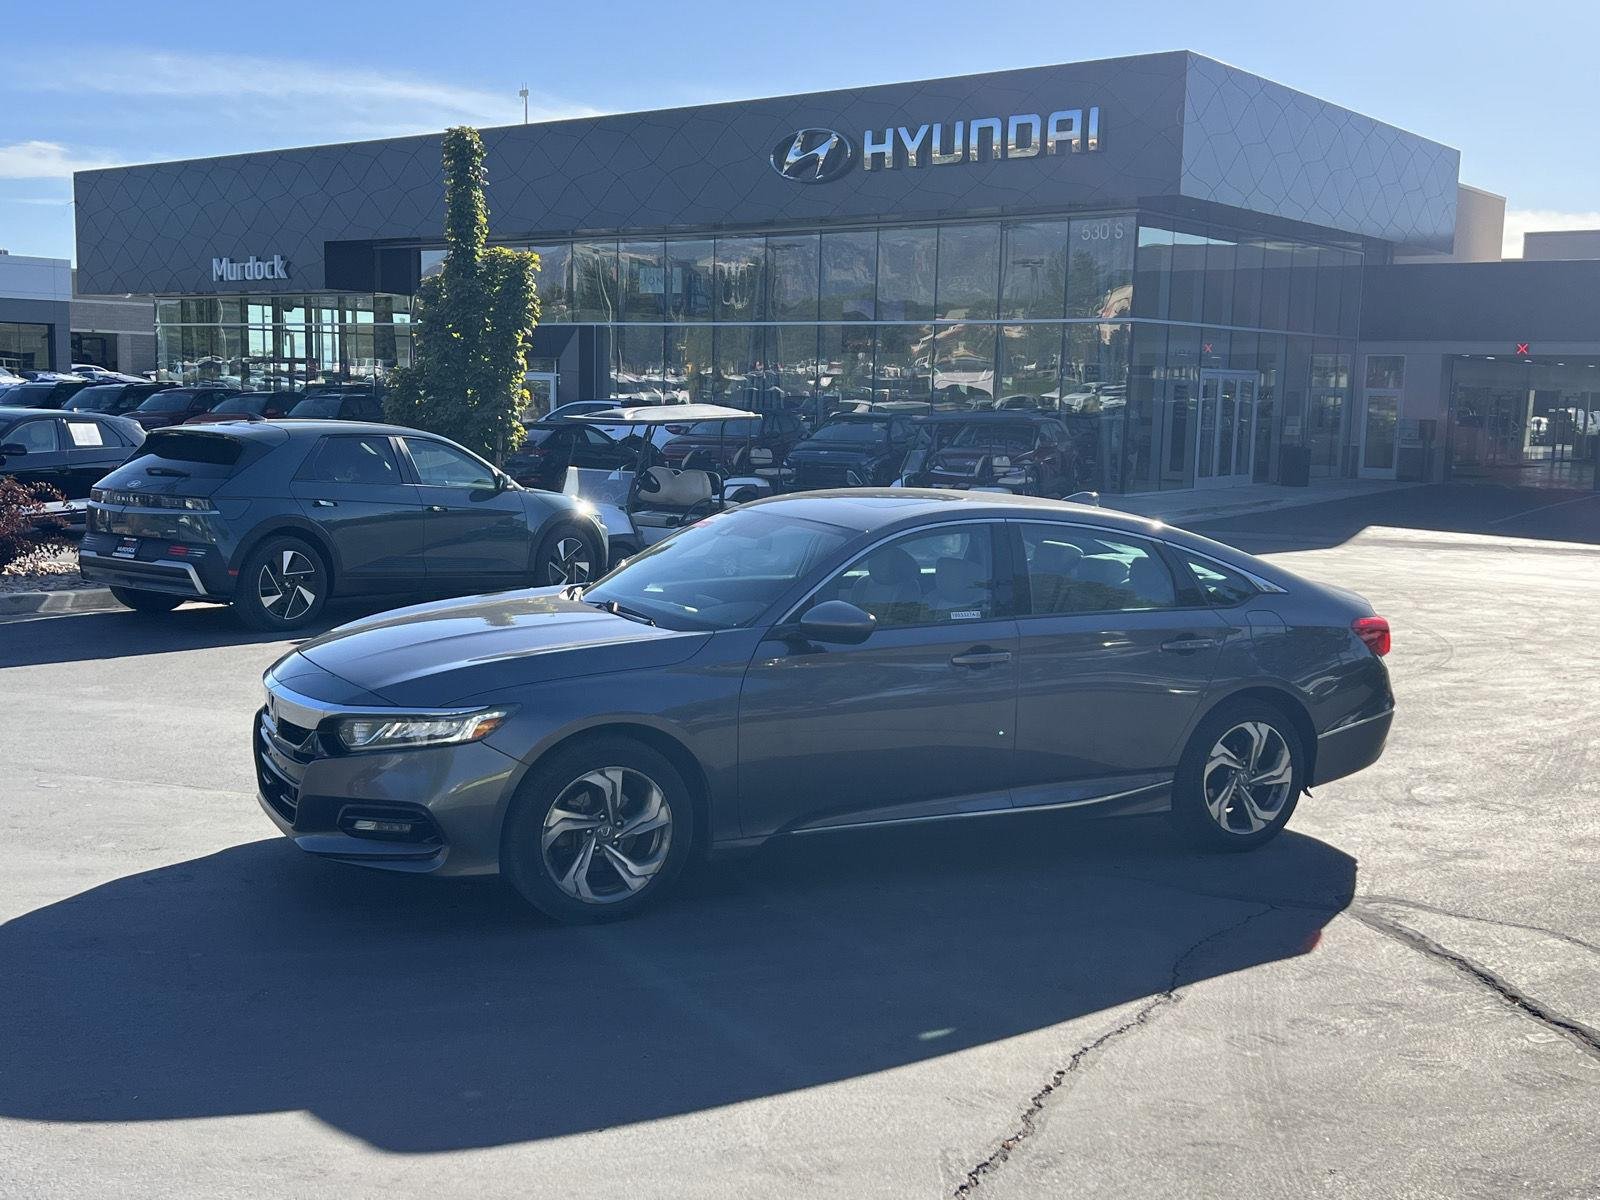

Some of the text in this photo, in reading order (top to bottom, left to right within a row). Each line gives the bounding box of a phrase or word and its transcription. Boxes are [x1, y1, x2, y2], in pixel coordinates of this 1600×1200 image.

[863, 106, 1099, 171] HYUNDAI
[1081, 222, 1124, 241] 530 S
[212, 254, 288, 282] Murdock
